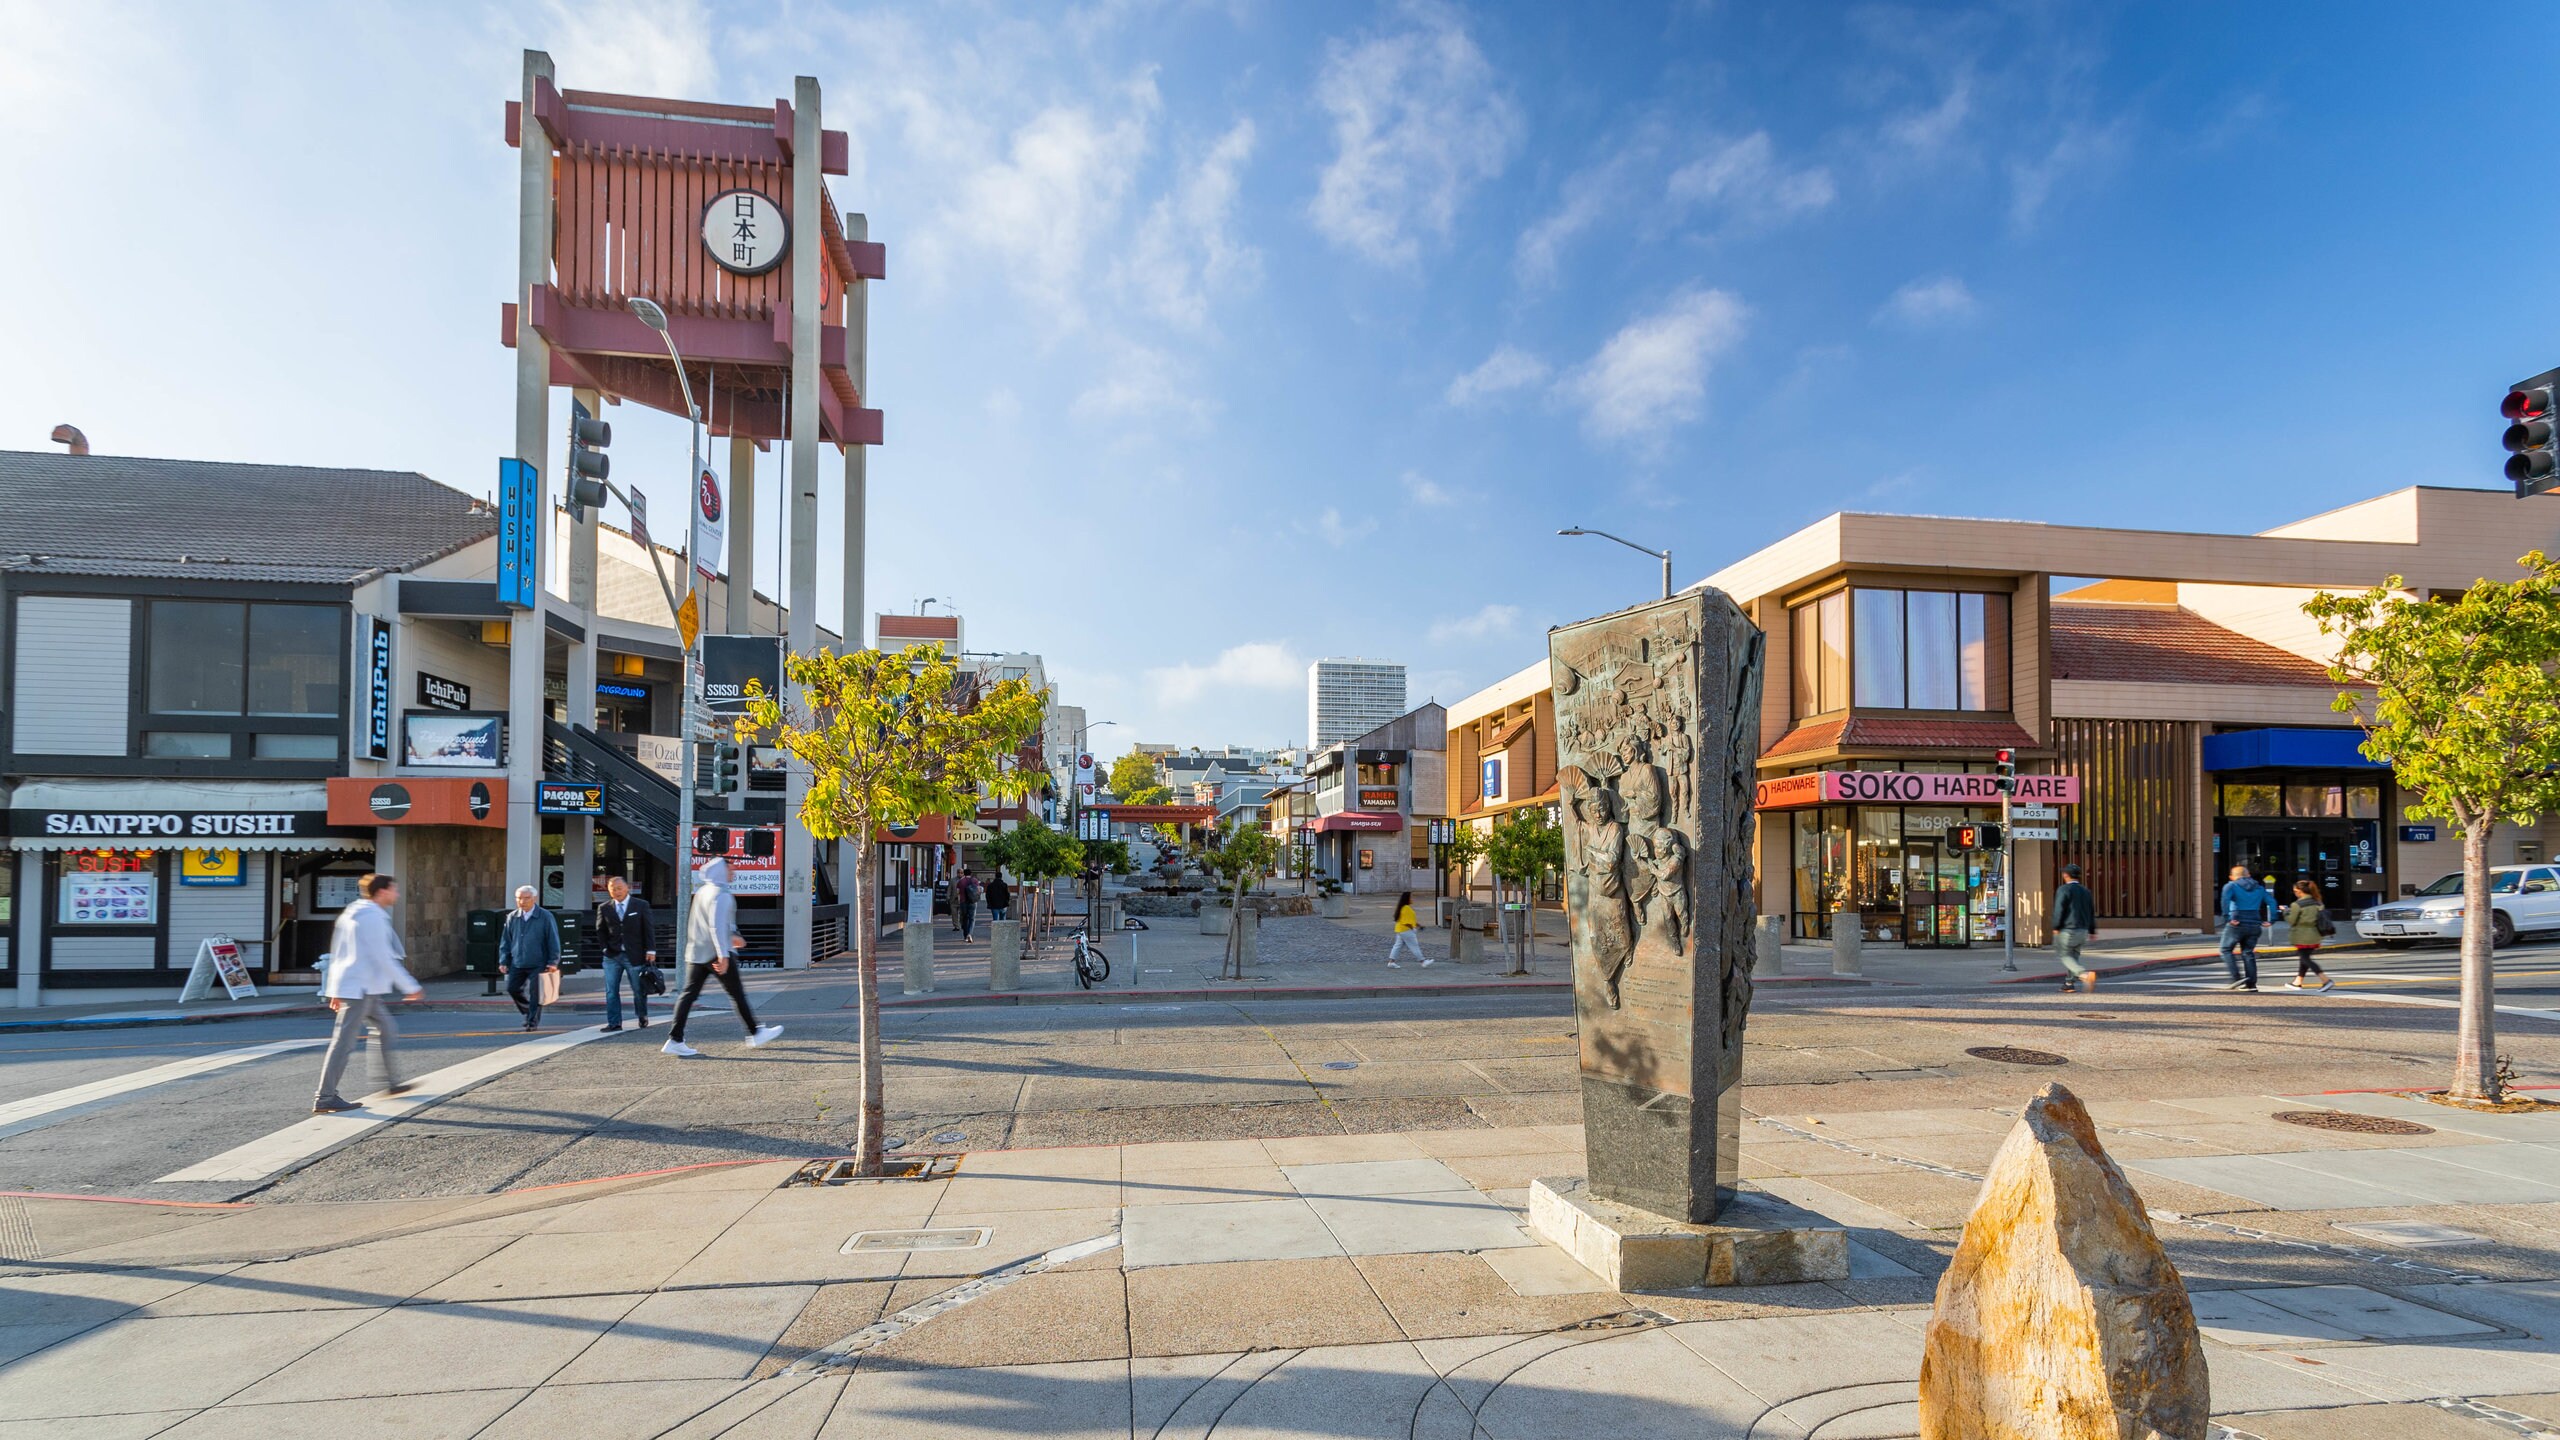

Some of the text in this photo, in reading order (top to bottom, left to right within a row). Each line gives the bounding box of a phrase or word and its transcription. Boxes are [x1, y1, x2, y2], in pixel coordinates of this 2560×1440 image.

[731, 194, 757, 267] 日本町
[506, 485, 517, 554] HUSH
[524, 477, 532, 567] HUSH
[371, 630, 389, 749] IchiPub
[425, 677, 467, 705] IchiPub
[707, 683, 739, 697] SSISSO
[1771, 776, 1816, 794] HARDWARE
[1838, 773, 1924, 801] SOKO
[543, 790, 585, 801] PAGODA
[1364, 791, 1395, 800] RAMEN
[45, 813, 296, 835] SANPPO SUSHI
[1919, 816, 1953, 830] 1698
[1962, 829, 1974, 845] 12
[2413, 833, 2430, 841] ATM
[78, 856, 141, 873] SUSHI
